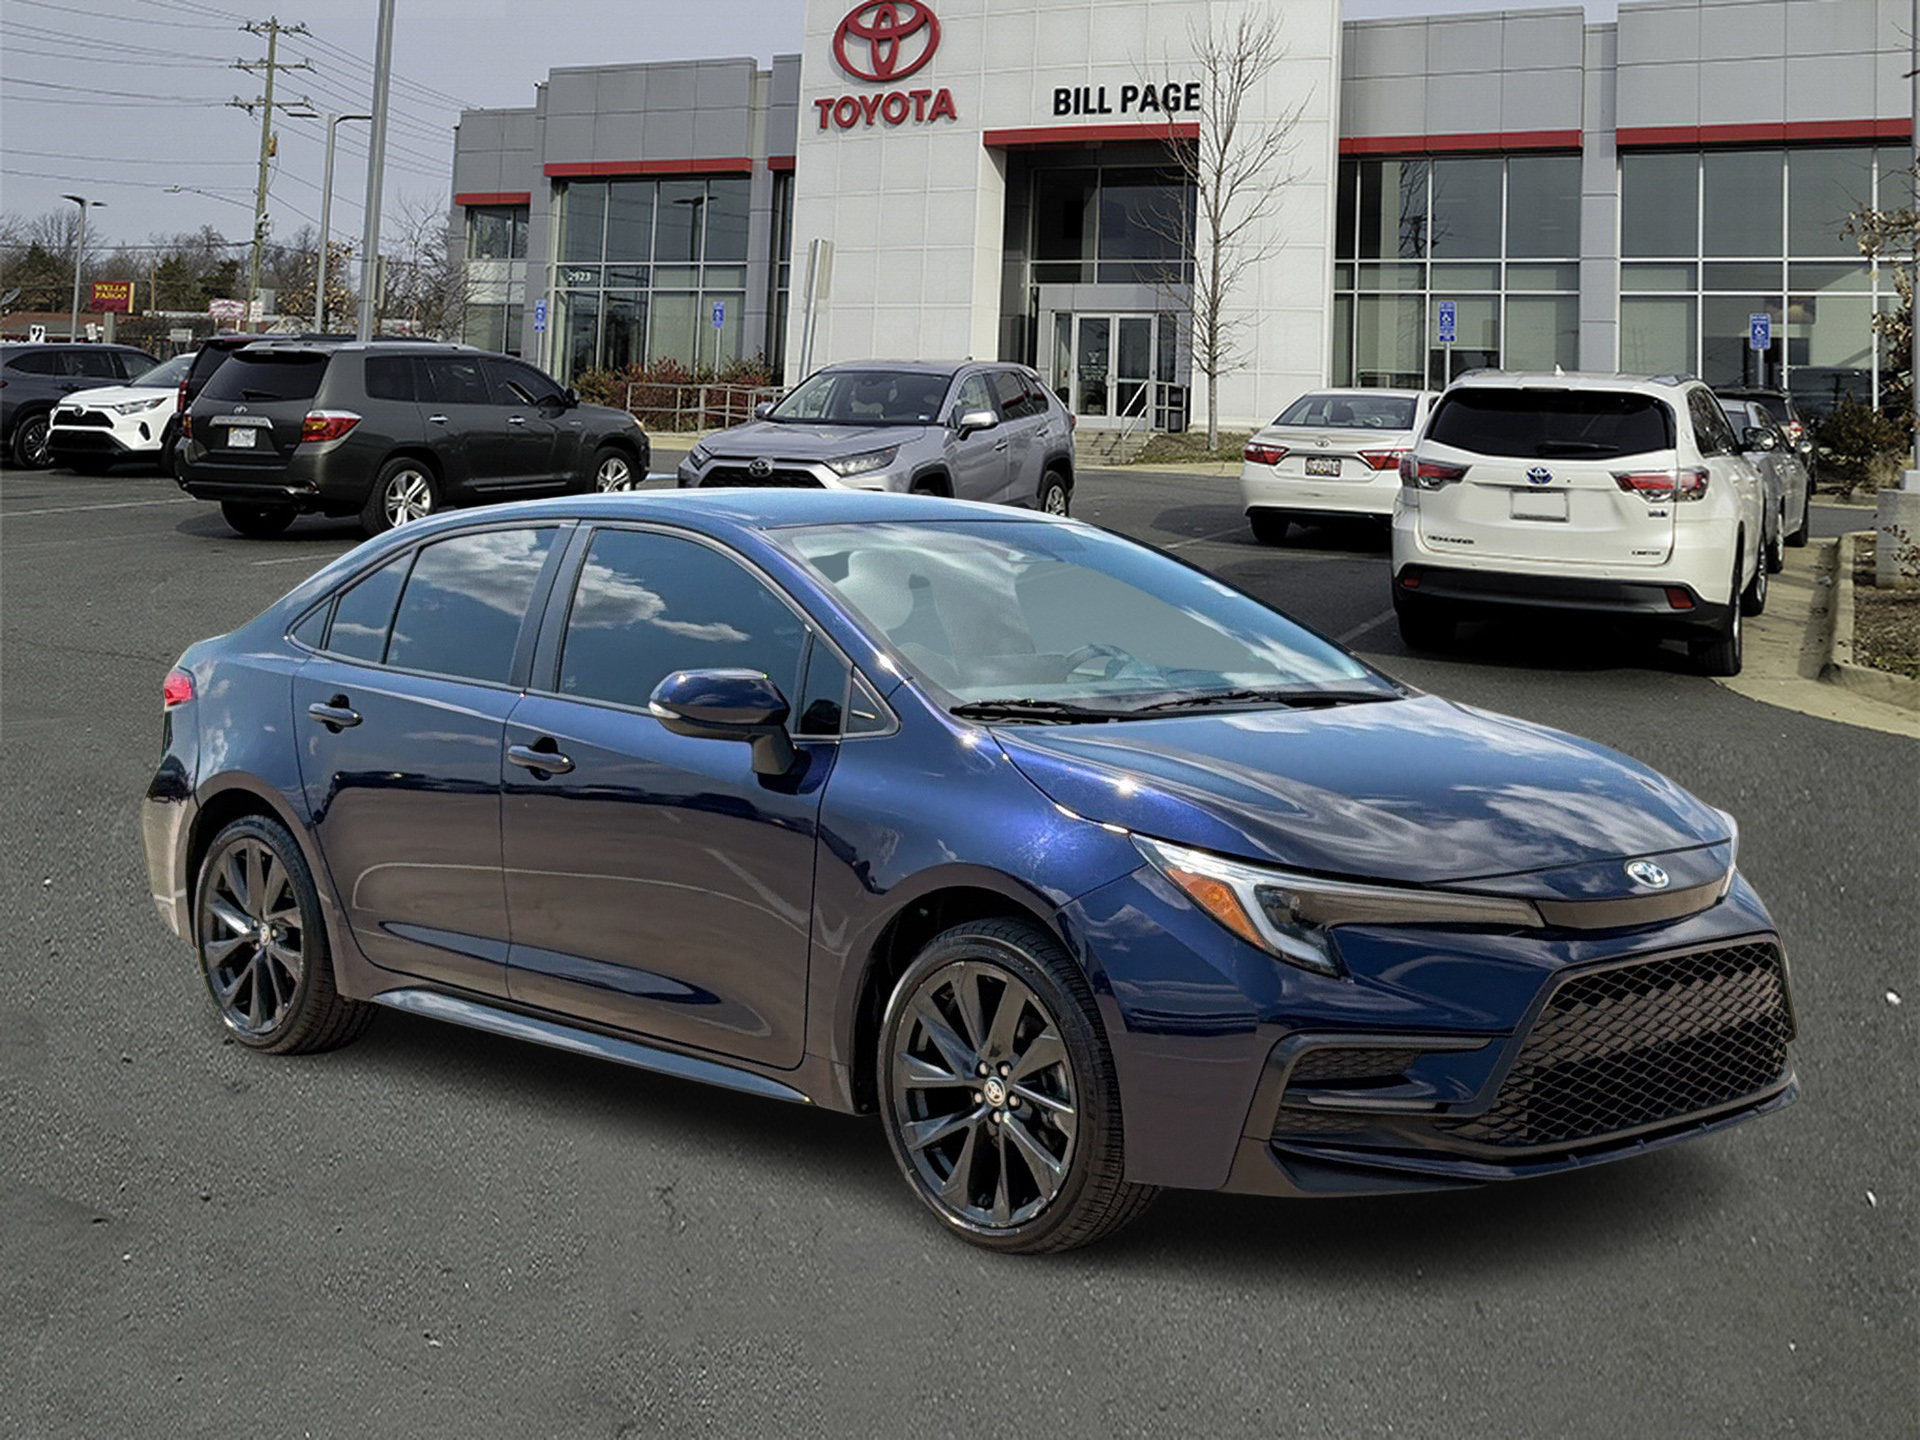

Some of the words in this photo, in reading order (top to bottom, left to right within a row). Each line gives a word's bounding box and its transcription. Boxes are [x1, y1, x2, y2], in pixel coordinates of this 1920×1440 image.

[814, 88, 957, 129] TOYOTA
[1053, 86, 1112, 115] BILL
[1121, 83, 1201, 113] PAGE
